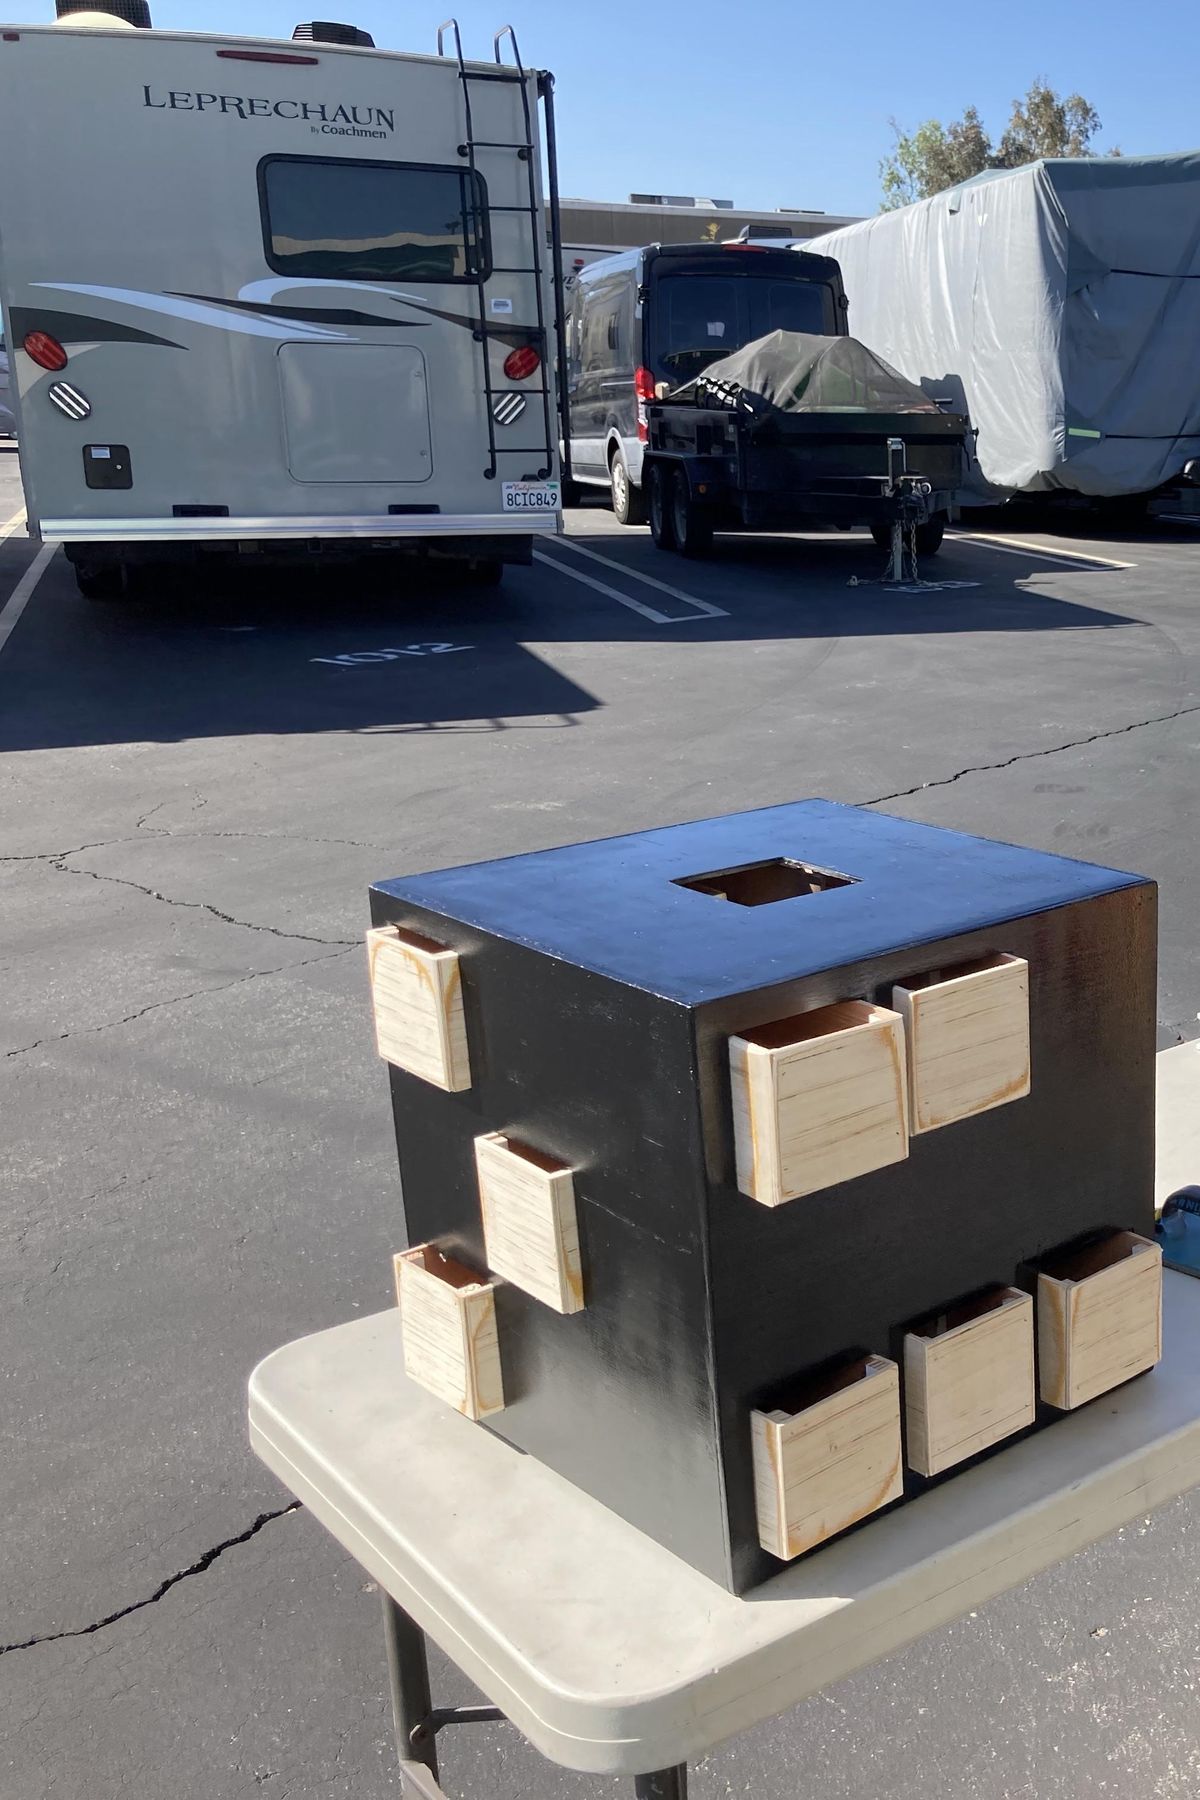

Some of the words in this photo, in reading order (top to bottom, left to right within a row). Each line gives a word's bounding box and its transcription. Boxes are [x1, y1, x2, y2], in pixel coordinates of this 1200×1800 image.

[142, 84, 395, 133] LEPRECHAUN
[310, 125, 320, 135] By
[321, 124, 387, 139] Coachmen
[506, 492, 558, 507] 8CIC849
[309, 642, 476, 666] 1012
